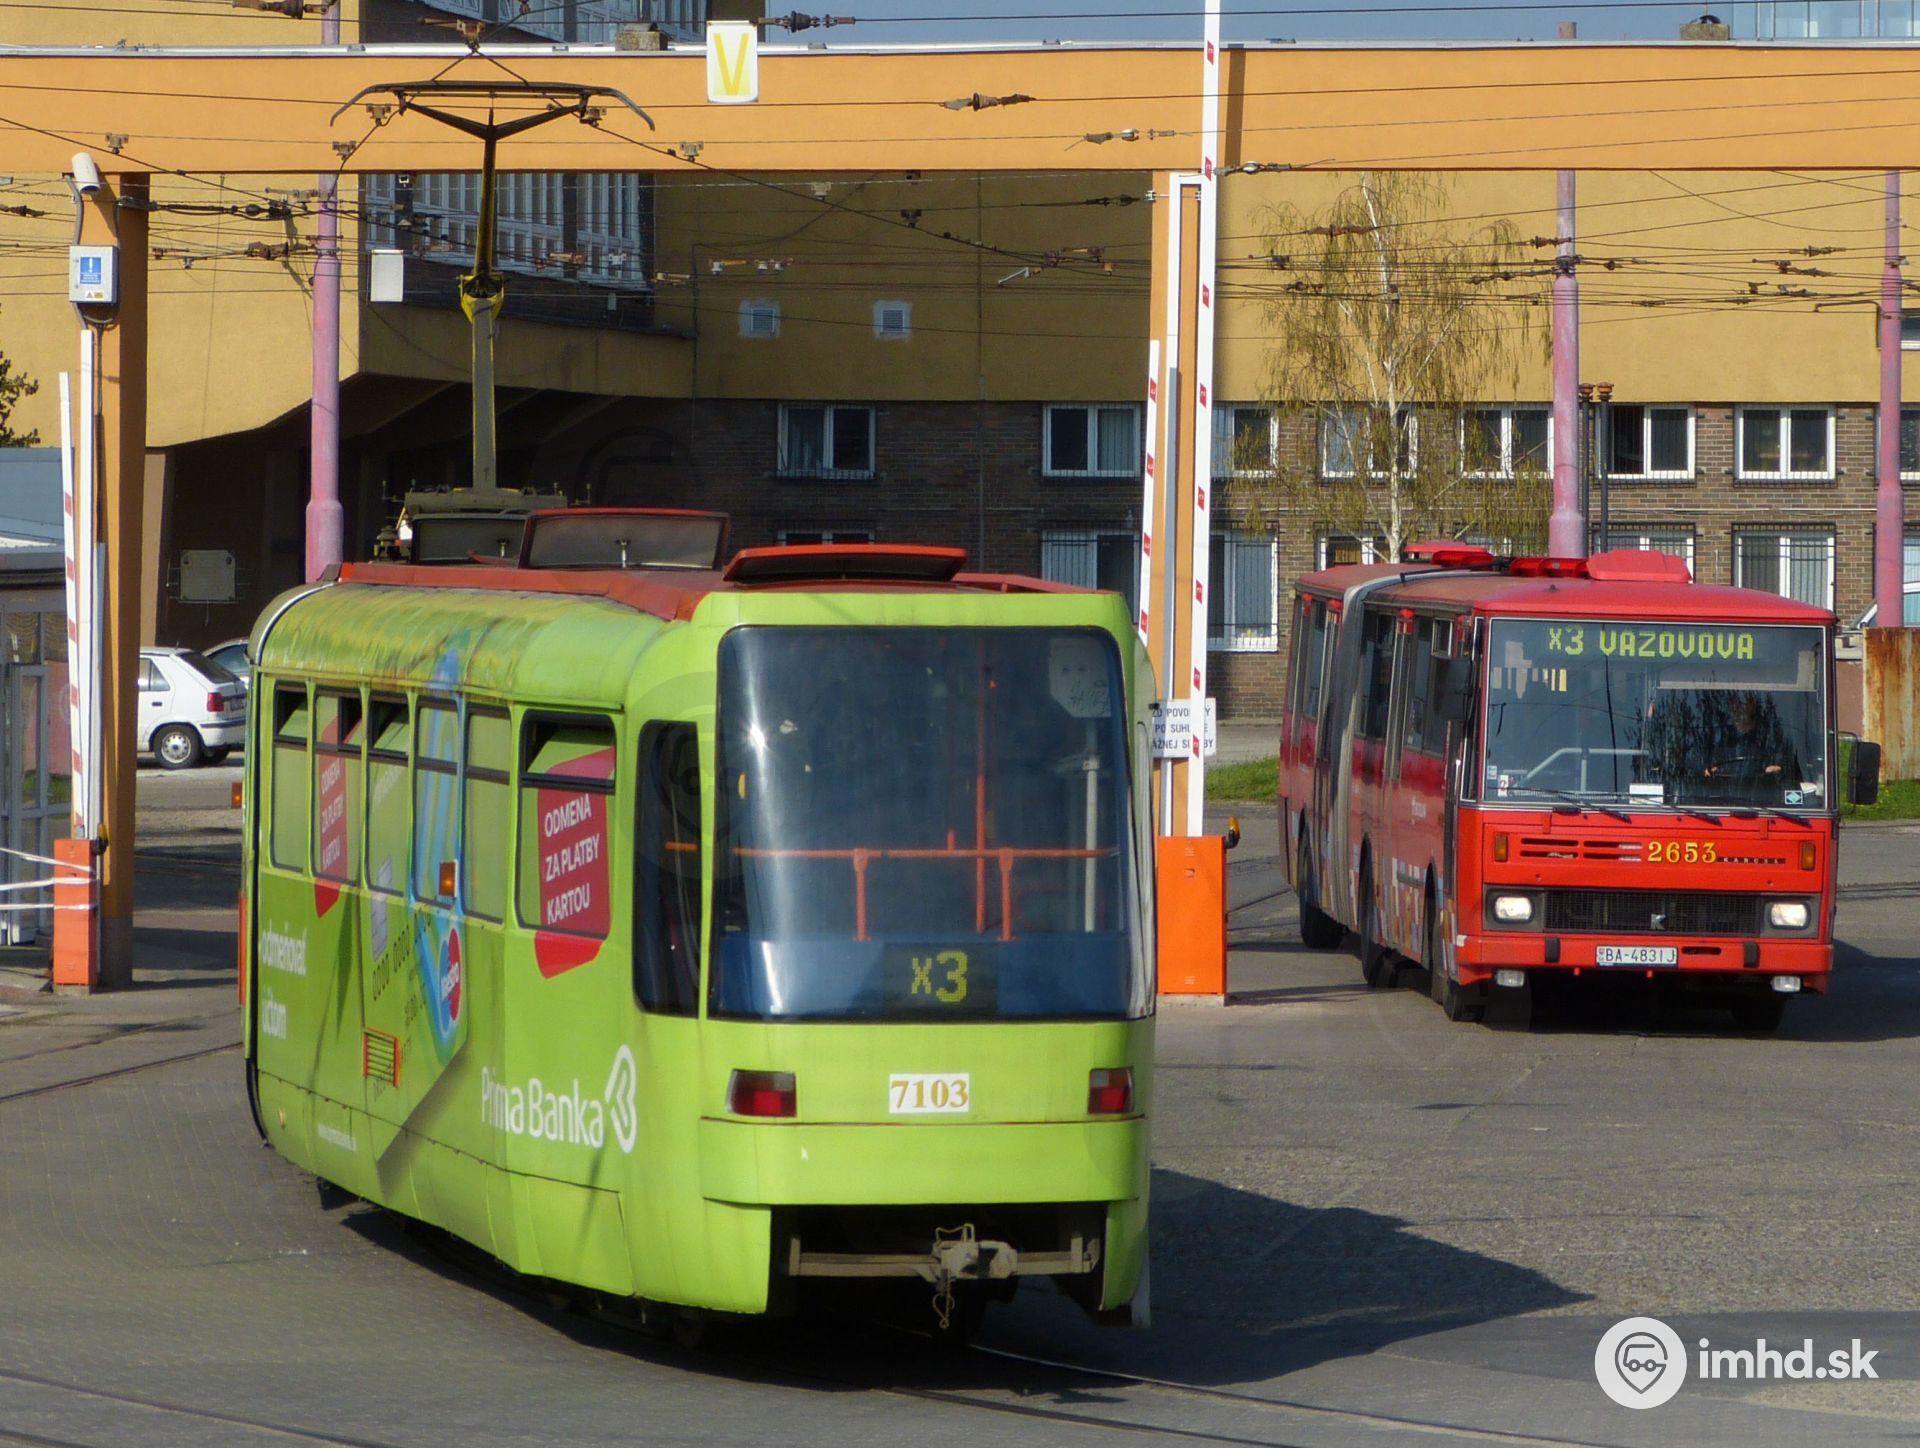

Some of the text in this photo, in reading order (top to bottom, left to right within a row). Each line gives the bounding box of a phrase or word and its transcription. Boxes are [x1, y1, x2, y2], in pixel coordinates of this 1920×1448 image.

[713, 32, 750, 96] V
[1549, 625, 1754, 660] X3 VAZOVOVA
[1154, 723, 1166, 734] PO
[544, 793, 592, 838] ODMENA
[545, 833, 600, 882] ZA PLATBY
[1648, 841, 1717, 863] 2653
[547, 883, 591, 926] KARTOU
[911, 950, 968, 1003] X3
[481, 1065, 525, 1135] Prima
[527, 1076, 604, 1149] Banka
[890, 1078, 969, 1109] 7103
